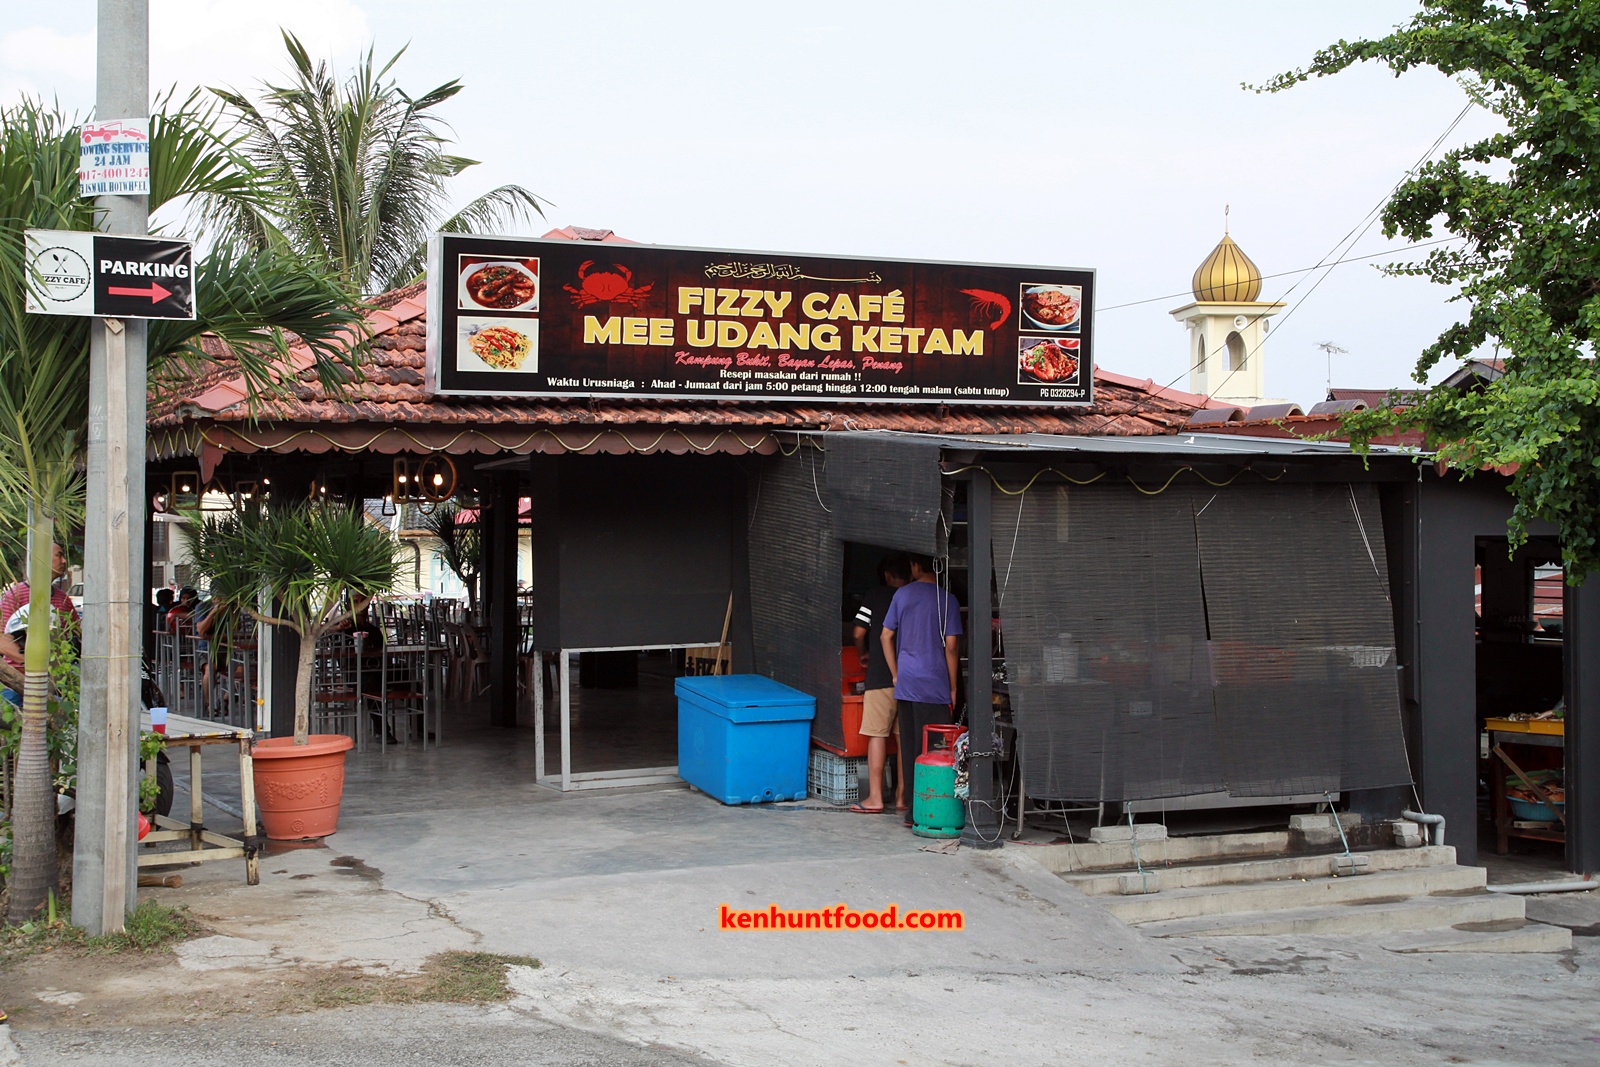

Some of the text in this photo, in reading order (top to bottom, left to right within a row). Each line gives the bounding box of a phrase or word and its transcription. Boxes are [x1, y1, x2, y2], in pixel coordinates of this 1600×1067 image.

[80, 143, 149, 156] TOWING SERVICE
[94, 155, 131, 167] 24 JAM
[100, 260, 189, 278] PARKING
[678, 286, 905, 322] FIZZY CAFÉ
[583, 315, 984, 355] MEE UDANG KETAM
[675, 351, 732, 369] Kampung
[778, 353, 815, 370] Bayan
[817, 355, 856, 371] Lepas,
[862, 356, 903, 374] Penang
[720, 369, 751, 380] Resepi
[755, 371, 797, 379] masakan
[800, 371, 818, 380] dari
[821, 373, 851, 381] rumah
[547, 377, 580, 387] Waktu
[582, 378, 635, 389] Urusniaga
[651, 379, 676, 388] Ahad
[684, 380, 720, 390] Jumaat
[723, 381, 742, 390] dari
[745, 382, 763, 391] jam
[766, 382, 788, 391] 5:00
[791, 383, 823, 393] petang
[825, 383, 857, 394] hingga
[860, 384, 887, 393] 12:00
[890, 385, 920, 395] tengah
[923, 386, 951, 394] malam
[954, 386, 981, 396] (sabtu
[984, 387, 1009, 397] tutup)
[1040, 388, 1049, 397] PG
